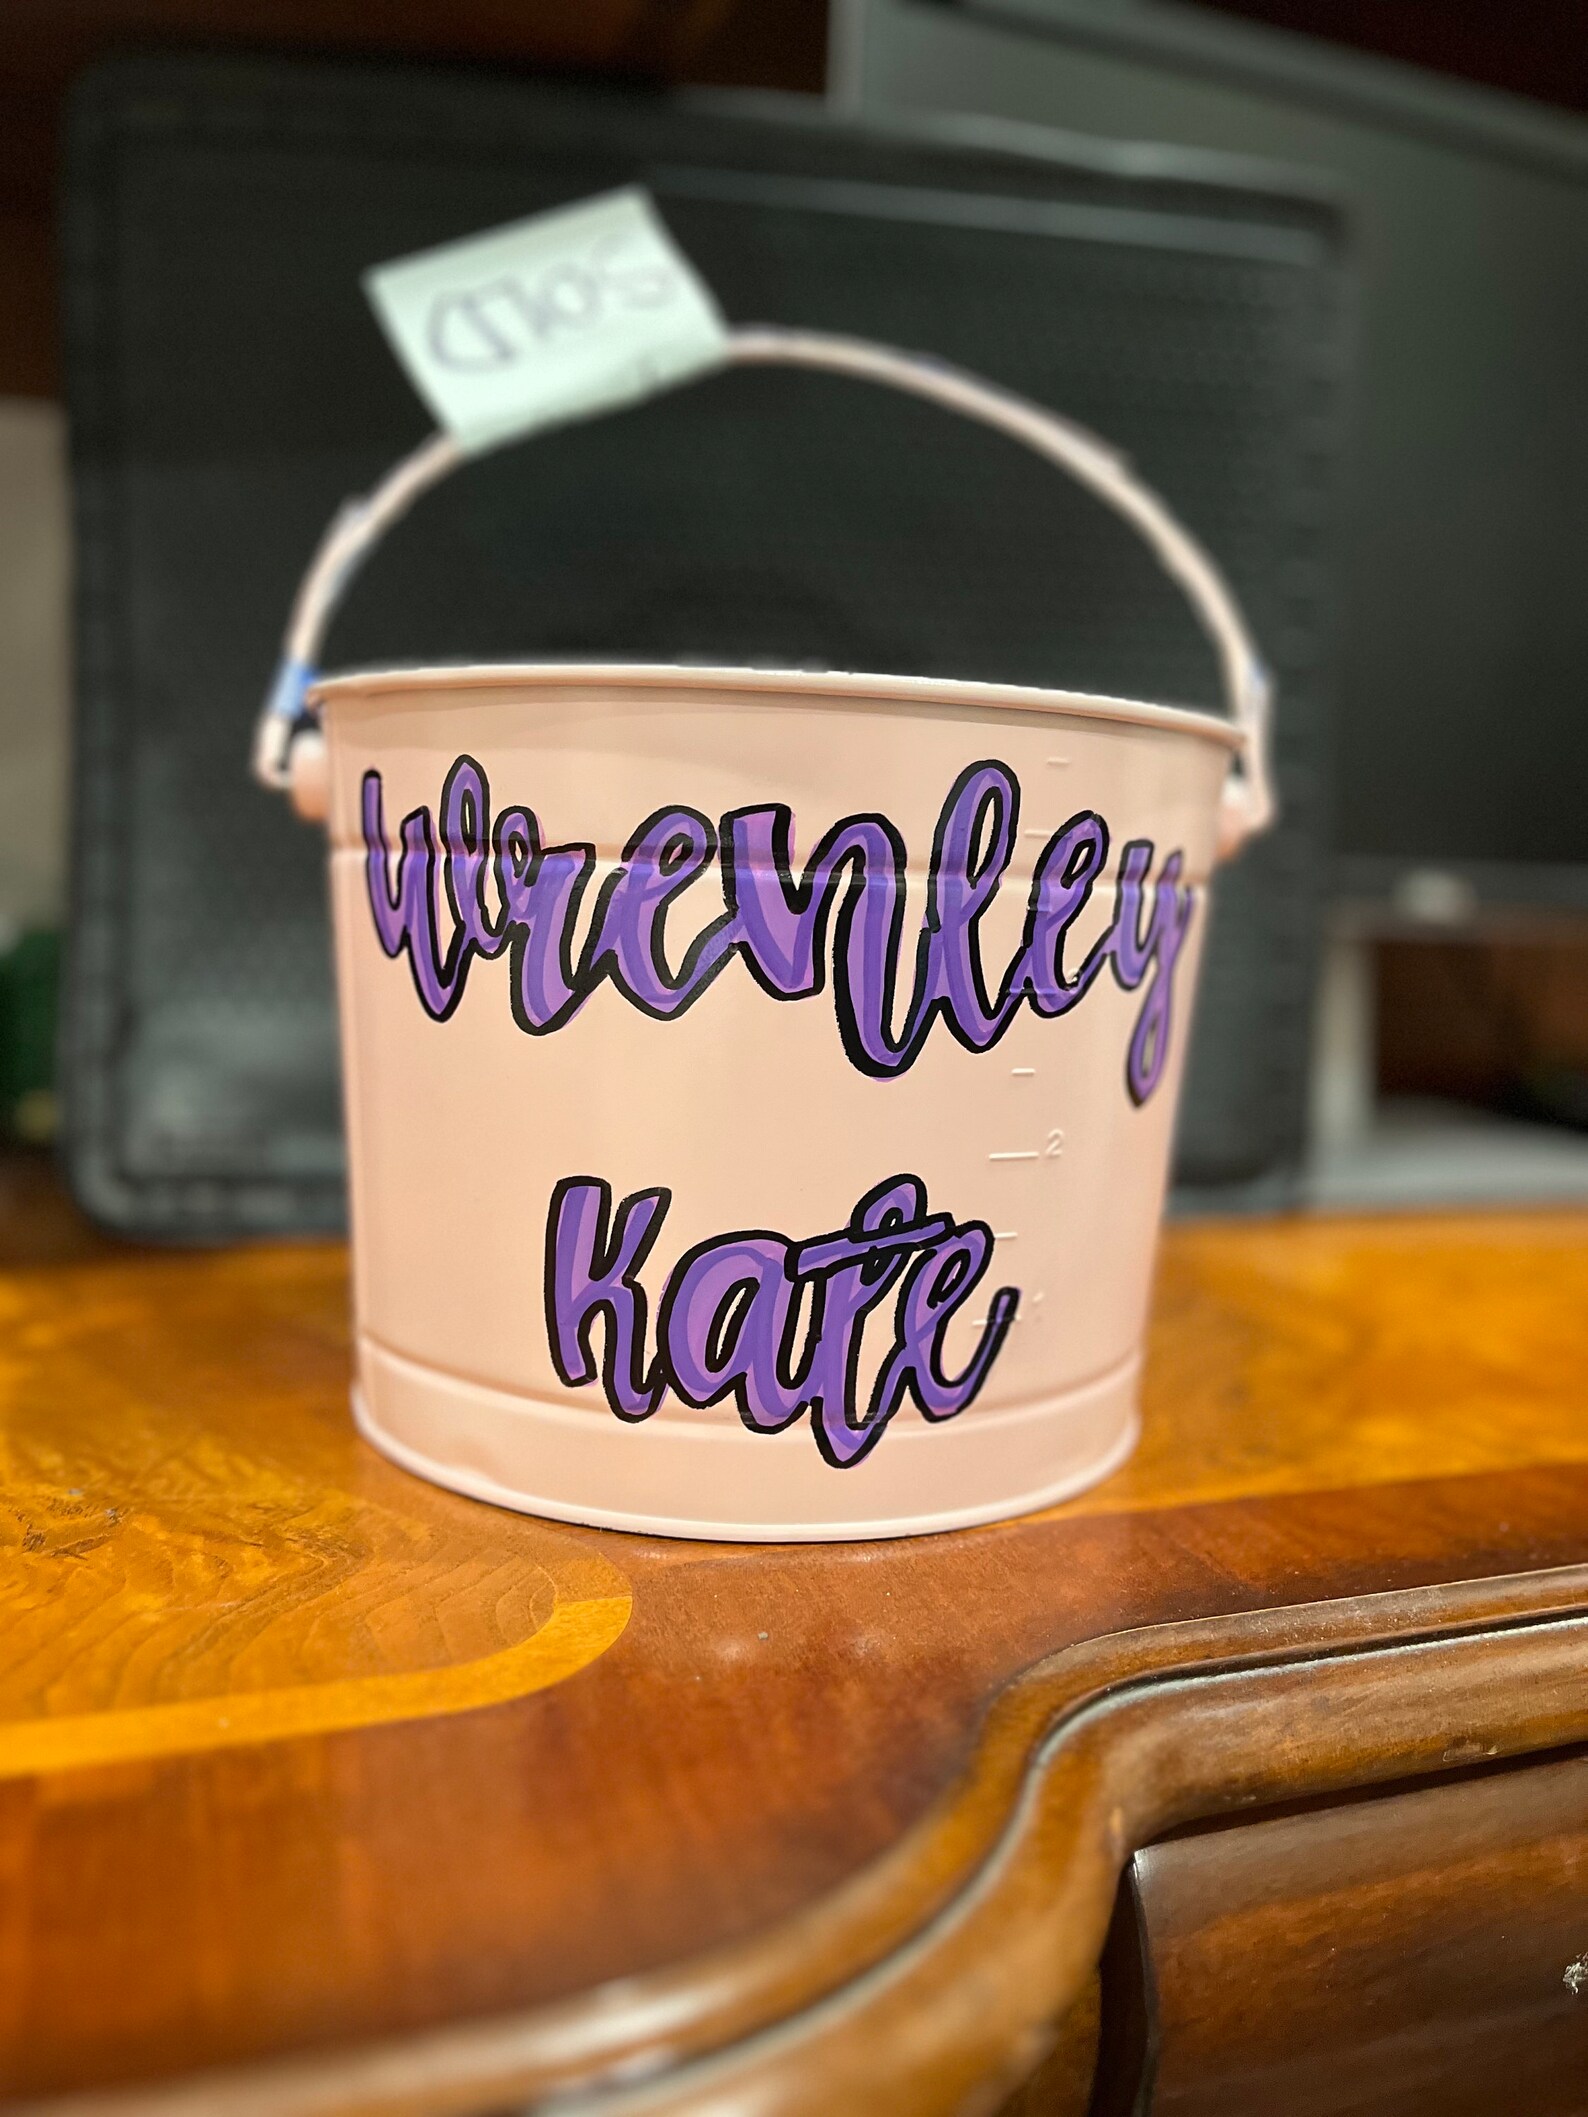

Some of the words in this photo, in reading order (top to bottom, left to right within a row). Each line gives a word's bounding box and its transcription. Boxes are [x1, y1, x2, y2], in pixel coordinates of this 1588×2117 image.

[424, 234, 680, 375] SOLD
[1045, 1127, 1065, 1158] 2
[545, 1174, 1020, 1469] Kate
